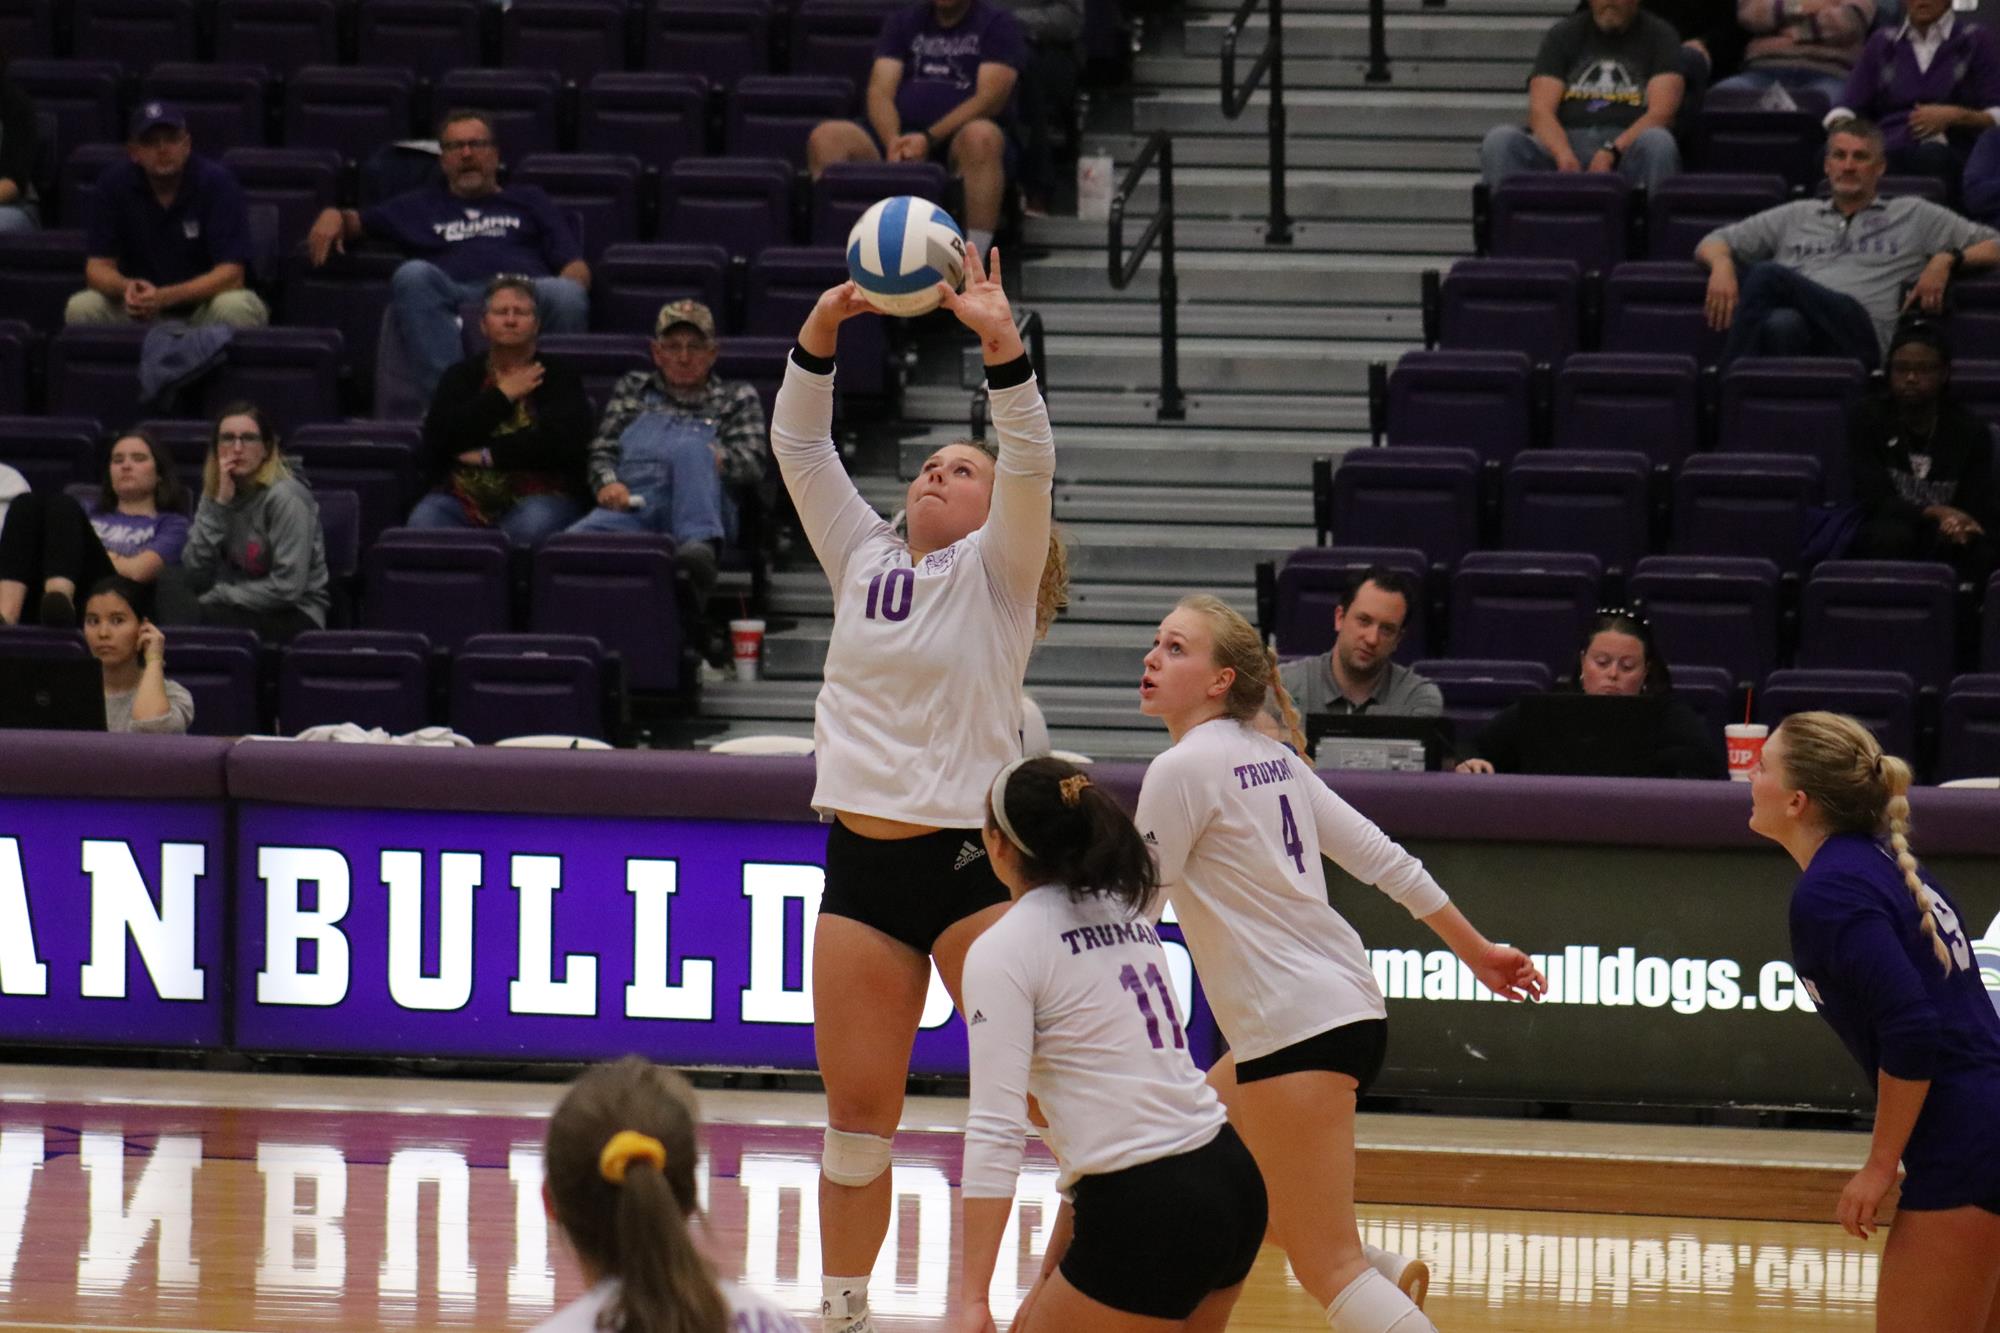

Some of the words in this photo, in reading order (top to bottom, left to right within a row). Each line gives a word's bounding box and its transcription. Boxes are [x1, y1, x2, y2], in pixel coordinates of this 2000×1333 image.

[865, 567, 915, 622] 10
[953, 848, 986, 871] adidas
[1278, 793, 1306, 874] 4
[1118, 962, 1185, 1050] 11
